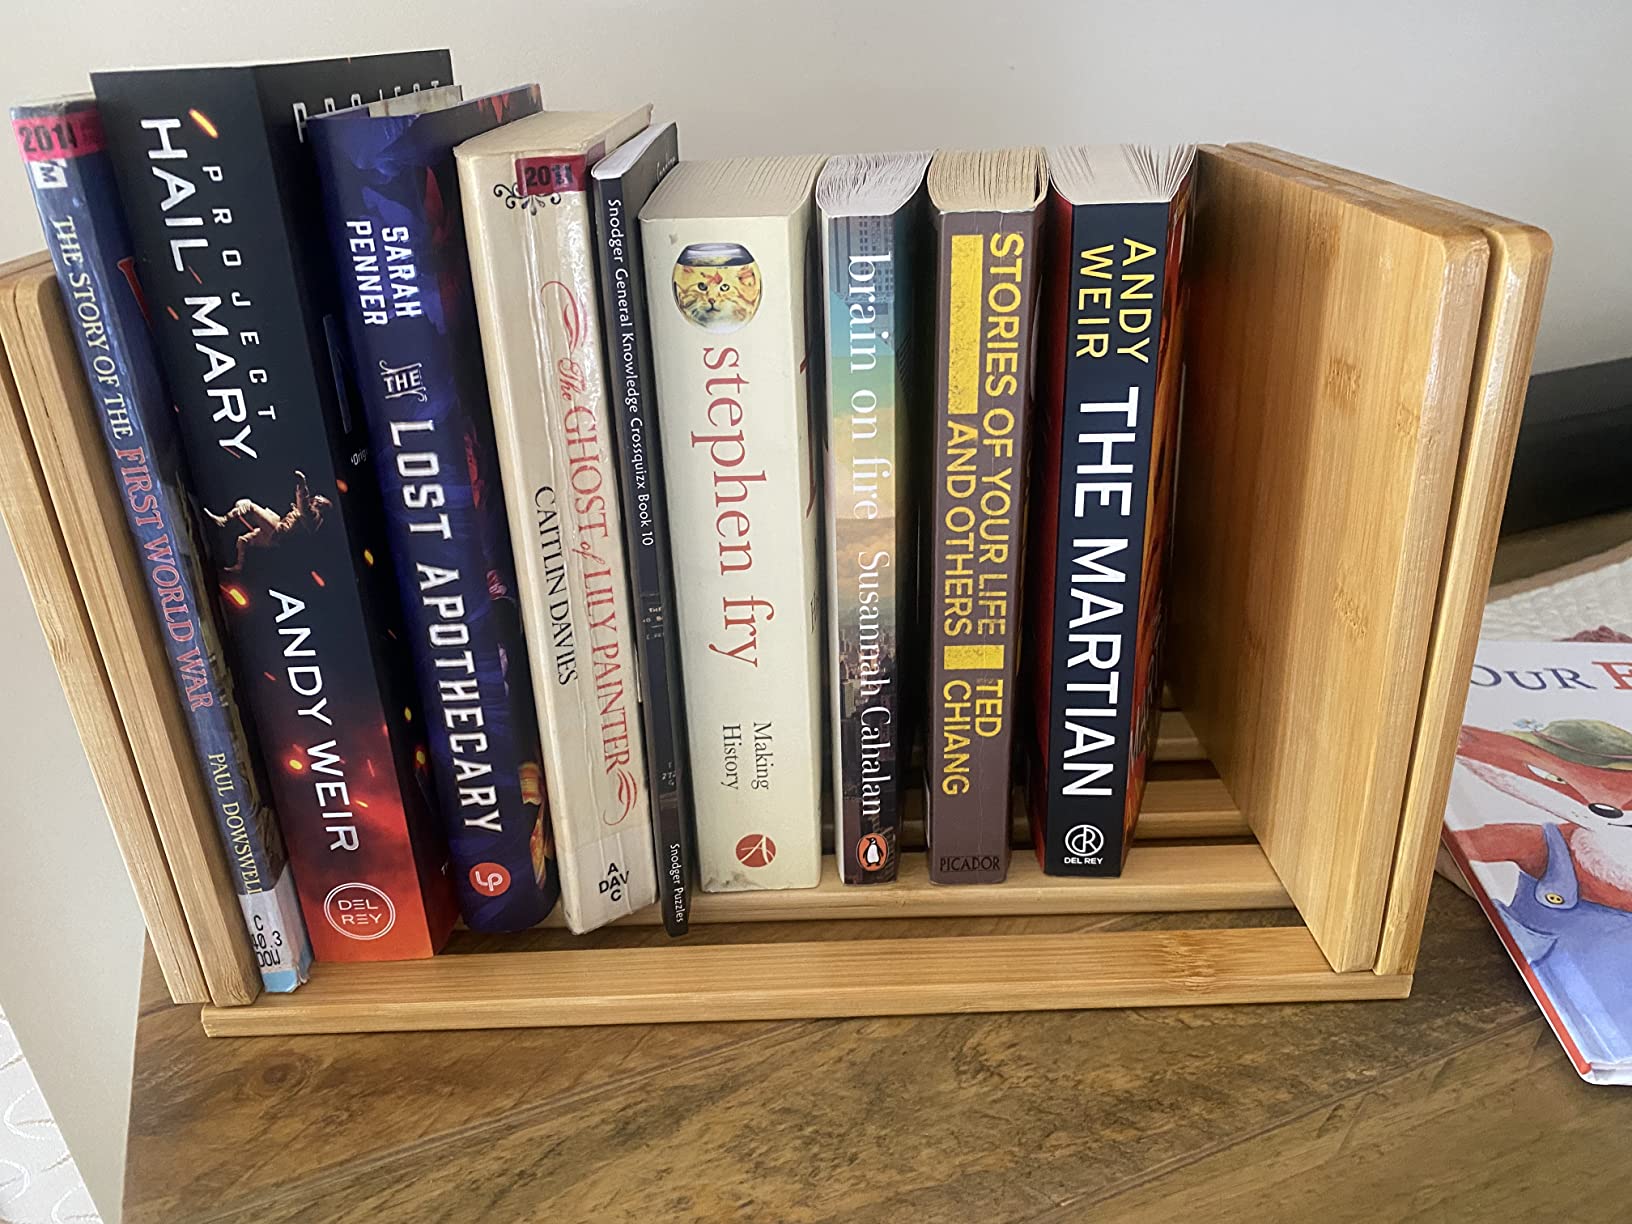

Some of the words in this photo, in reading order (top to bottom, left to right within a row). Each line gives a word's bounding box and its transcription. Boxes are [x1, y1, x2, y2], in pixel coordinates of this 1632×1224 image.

[525, 163, 573, 187] 2011
[50, 216, 82, 265] THE
[608, 199, 623, 263] Snodger
[140, 118, 209, 271] HAIL
[184, 297, 258, 458] MARY
[202, 165, 276, 420] PROJECT
[347, 220, 388, 326] PENNER
[382, 226, 422, 318] SARAH
[615, 268, 632, 331] General
[1076, 245, 1113, 358] WEIR
[1117, 238, 1156, 363] ANDY
[69, 270, 108, 353] STORY
[848, 252, 891, 373] brain
[985, 232, 1025, 396] STORIES
[93, 355, 120, 387] OF
[382, 362, 426, 400] THE
[558, 357, 587, 401] The
[622, 332, 640, 414] Knowledge
[104, 393, 133, 439] THE
[851, 391, 877, 440] on
[983, 407, 1014, 458] OF
[390, 420, 451, 539] LOST
[564, 405, 609, 538] GHOST
[630, 418, 648, 489] Crossquizx
[691, 347, 767, 575] stephen
[946, 420, 977, 498] AND
[1074, 386, 1139, 517] THE
[114, 446, 164, 532] FIRST
[639, 493, 650, 527] Book
[853, 457, 891, 520] fire
[979, 469, 1012, 563] YOUR
[573, 541, 605, 565] of
[641, 531, 654, 546] 10
[944, 507, 974, 636] OTHERS
[144, 535, 195, 642] WORLD
[534, 487, 566, 601] CAITLIN
[550, 603, 577, 685] DAVIES
[583, 567, 616, 637] LILY
[977, 573, 1006, 635] LIFE
[709, 596, 775, 668] fry
[858, 551, 890, 697] Susannah
[177, 645, 213, 711] WAR
[416, 562, 502, 833] APOTHECARY
[1062, 538, 1128, 795] MARTIAN
[268, 589, 332, 727] ANDY
[307, 740, 360, 853] WEIR
[594, 640, 632, 774] PAINTER
[943, 680, 970, 795] CHIANG
[974, 680, 1002, 737] TED
[208, 752, 235, 798] PAUL
[723, 725, 741, 790] History
[753, 722, 772, 790] Making
[862, 706, 890, 815] Cahalan
[599, 871, 629, 894] DAV
[608, 863, 618, 875] A
[611, 890, 621, 901] C
[668, 843, 682, 886] Snodger
[940, 856, 1000, 872] PICADOR
[254, 915, 263, 931] C
[338, 899, 378, 911] DEL
[342, 912, 384, 926] REY
[672, 886, 685, 922] Puzzles
